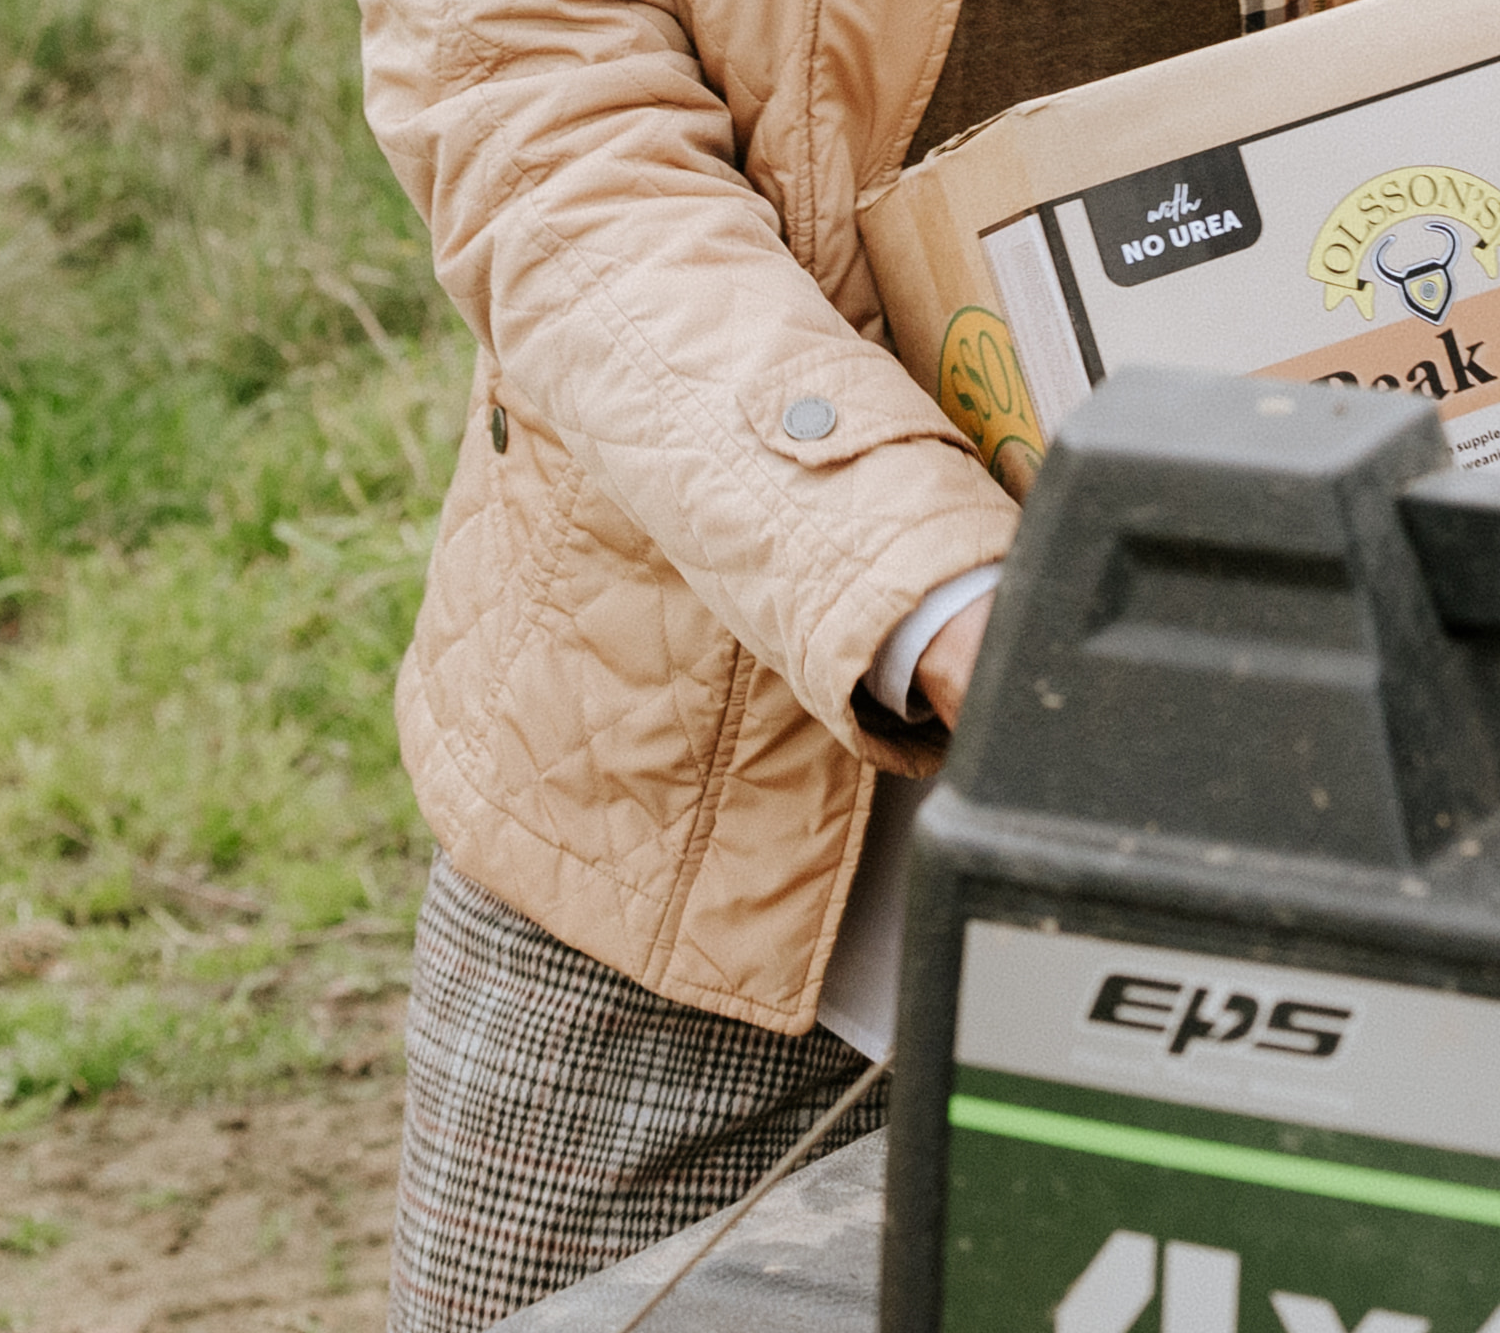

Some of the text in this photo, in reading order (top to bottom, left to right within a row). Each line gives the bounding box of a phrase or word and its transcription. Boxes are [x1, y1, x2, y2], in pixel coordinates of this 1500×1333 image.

[1147, 183, 1202, 222] with
[1121, 209, 1243, 265] NO UREA
